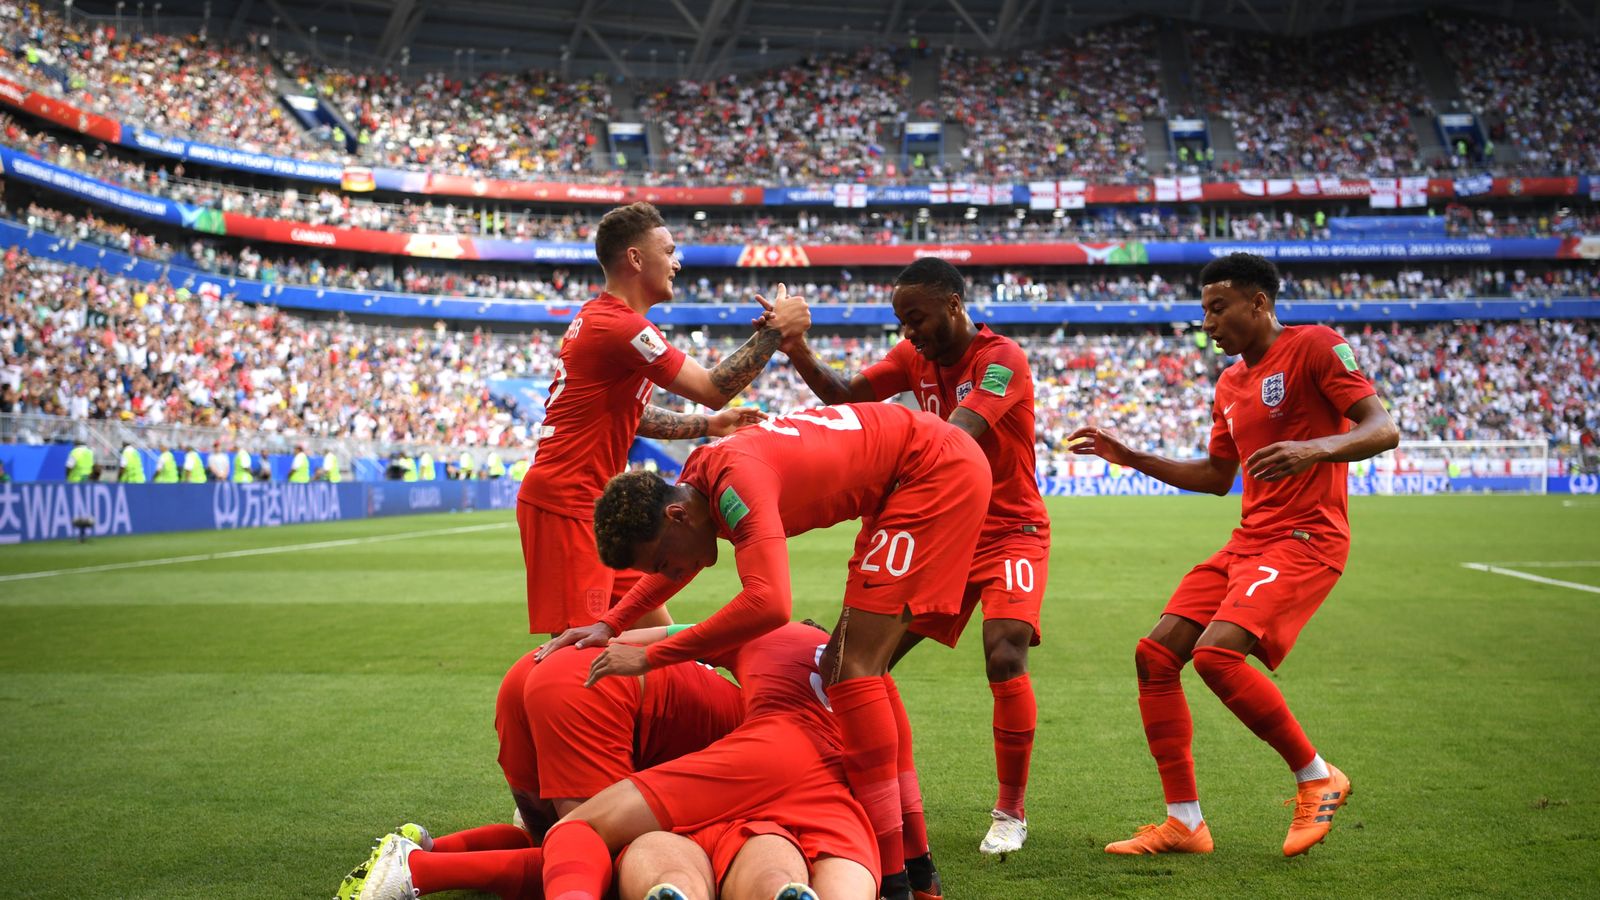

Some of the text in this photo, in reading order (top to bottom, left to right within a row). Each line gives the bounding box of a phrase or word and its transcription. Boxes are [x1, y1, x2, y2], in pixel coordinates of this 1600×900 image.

[21, 483, 133, 540] WANDA
[281, 482, 342, 524] WANDA
[860, 529, 915, 577] 20
[1004, 558, 1034, 593] 10
[1245, 565, 1279, 597] 7
